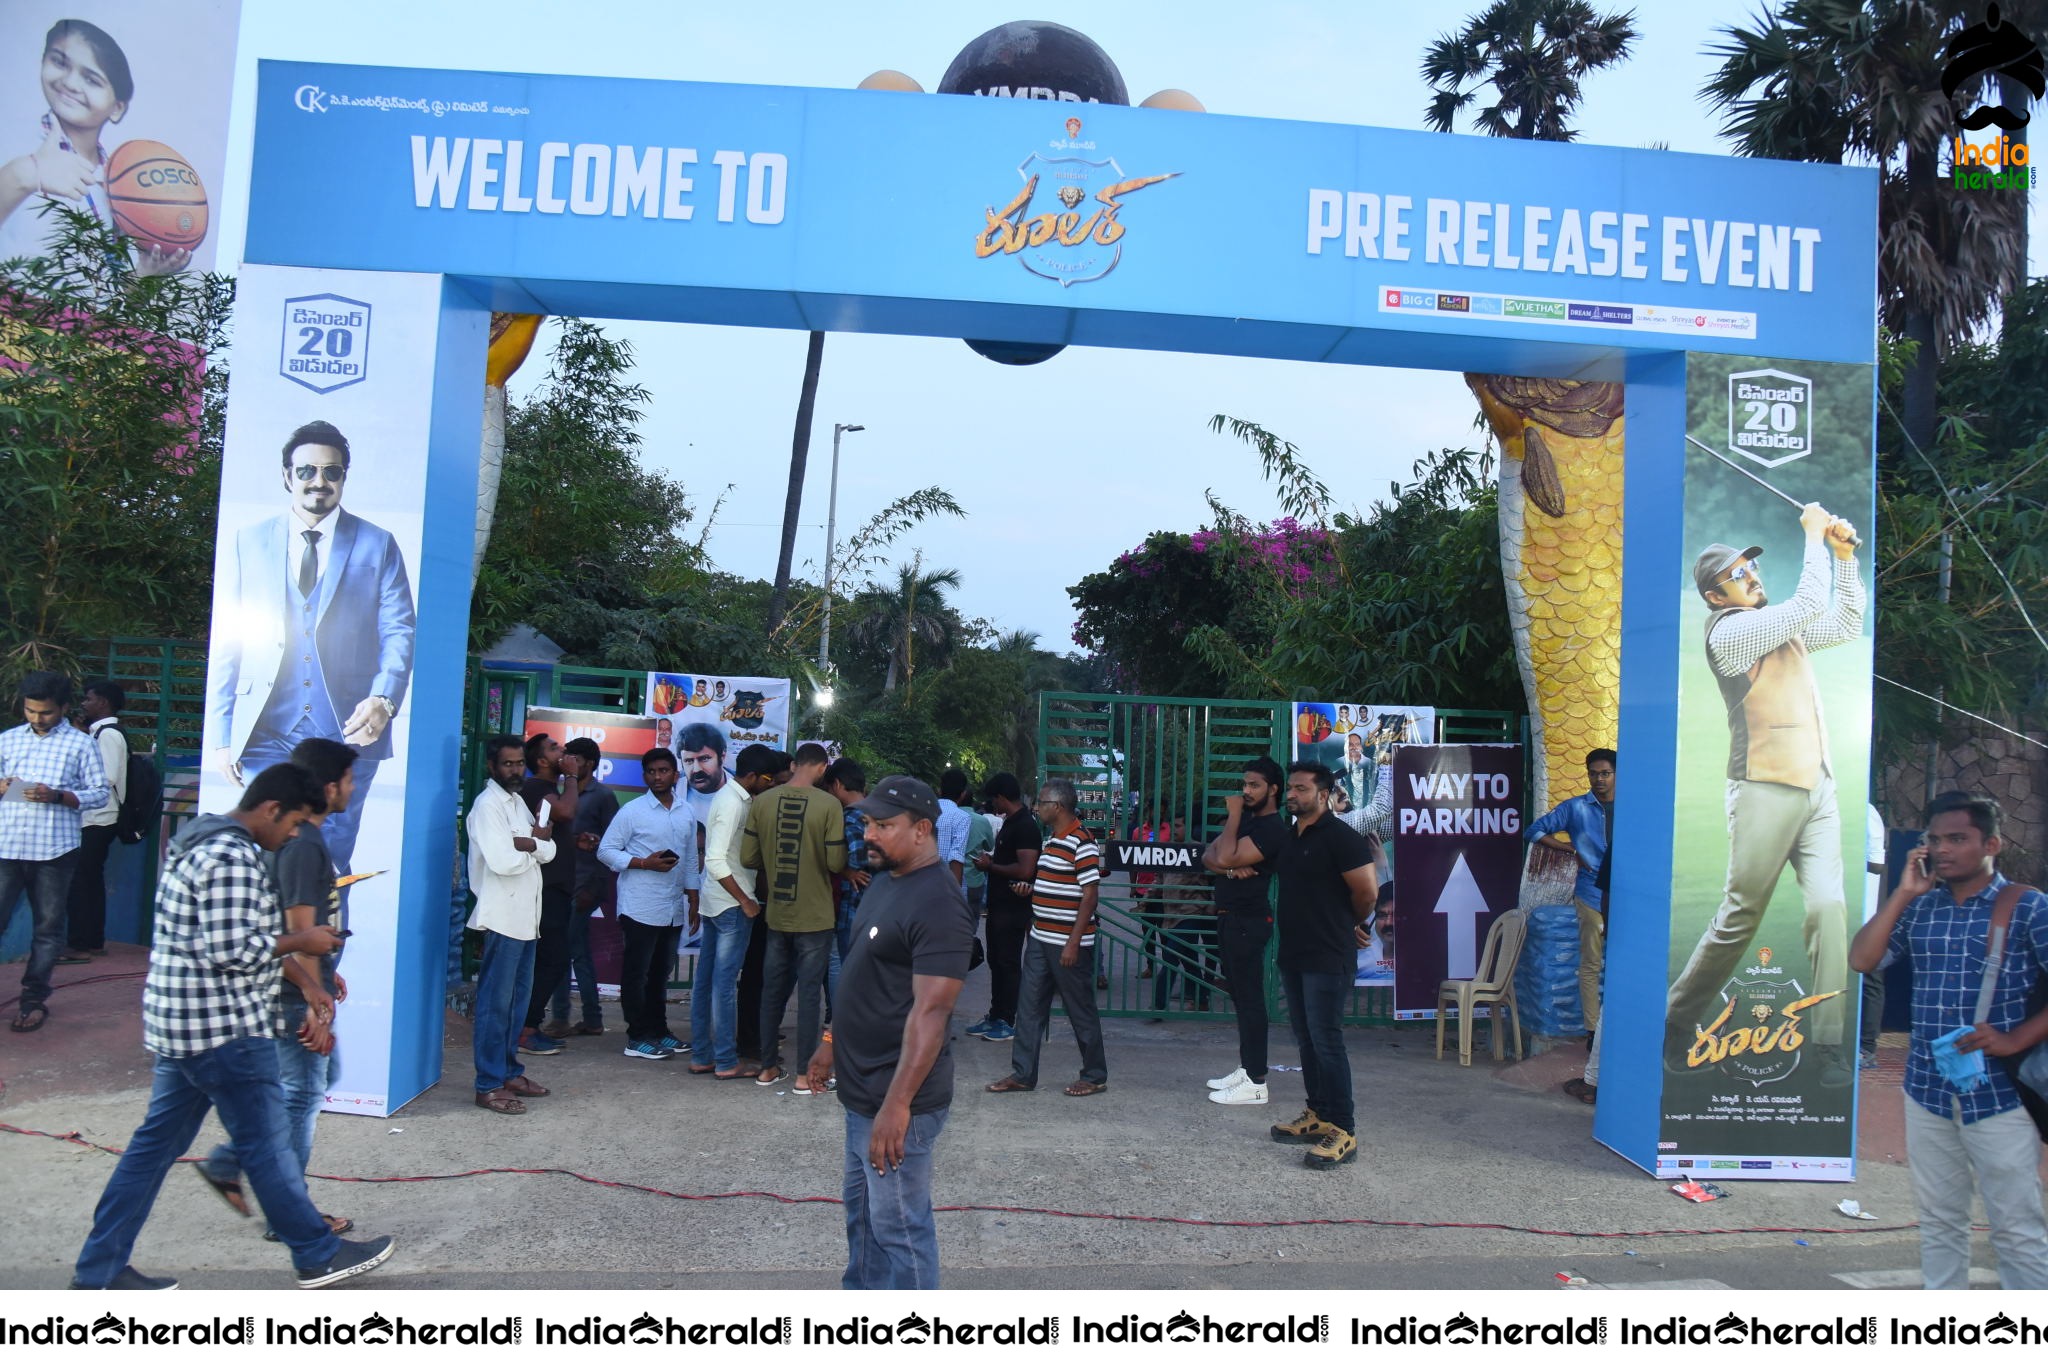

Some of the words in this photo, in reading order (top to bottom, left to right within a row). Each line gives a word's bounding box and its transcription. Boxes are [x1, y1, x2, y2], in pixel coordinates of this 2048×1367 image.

[136, 167, 199, 188] COSCO
[410, 135, 699, 221] WELCOME
[712, 149, 789, 225] TO
[1306, 188, 1413, 262] PRE
[1425, 198, 1650, 280] RELEASE
[1661, 215, 1823, 293] EVENT
[1402, 294, 1422, 306] BIG
[1425, 297, 1434, 307] C
[1514, 302, 1555, 313] VIJETHA
[293, 308, 363, 327] డిసెంబర్
[1570, 308, 1592, 317] DREAM
[1602, 311, 1632, 320] SHELTERS
[297, 326, 353, 358] 20
[289, 358, 359, 376] విడుదల
[1737, 383, 1805, 403] డిసెంబర్
[1744, 400, 1797, 433] 20
[1737, 431, 1805, 450] విడుదల
[1408, 773, 1472, 800] WAY
[1472, 773, 1510, 800] TO
[1400, 807, 1520, 835] PARKING
[1118, 846, 1193, 867] VMRDA
[1741, 1065, 1775, 1076] POLICE
[346, 1256, 382, 1275] crocs
